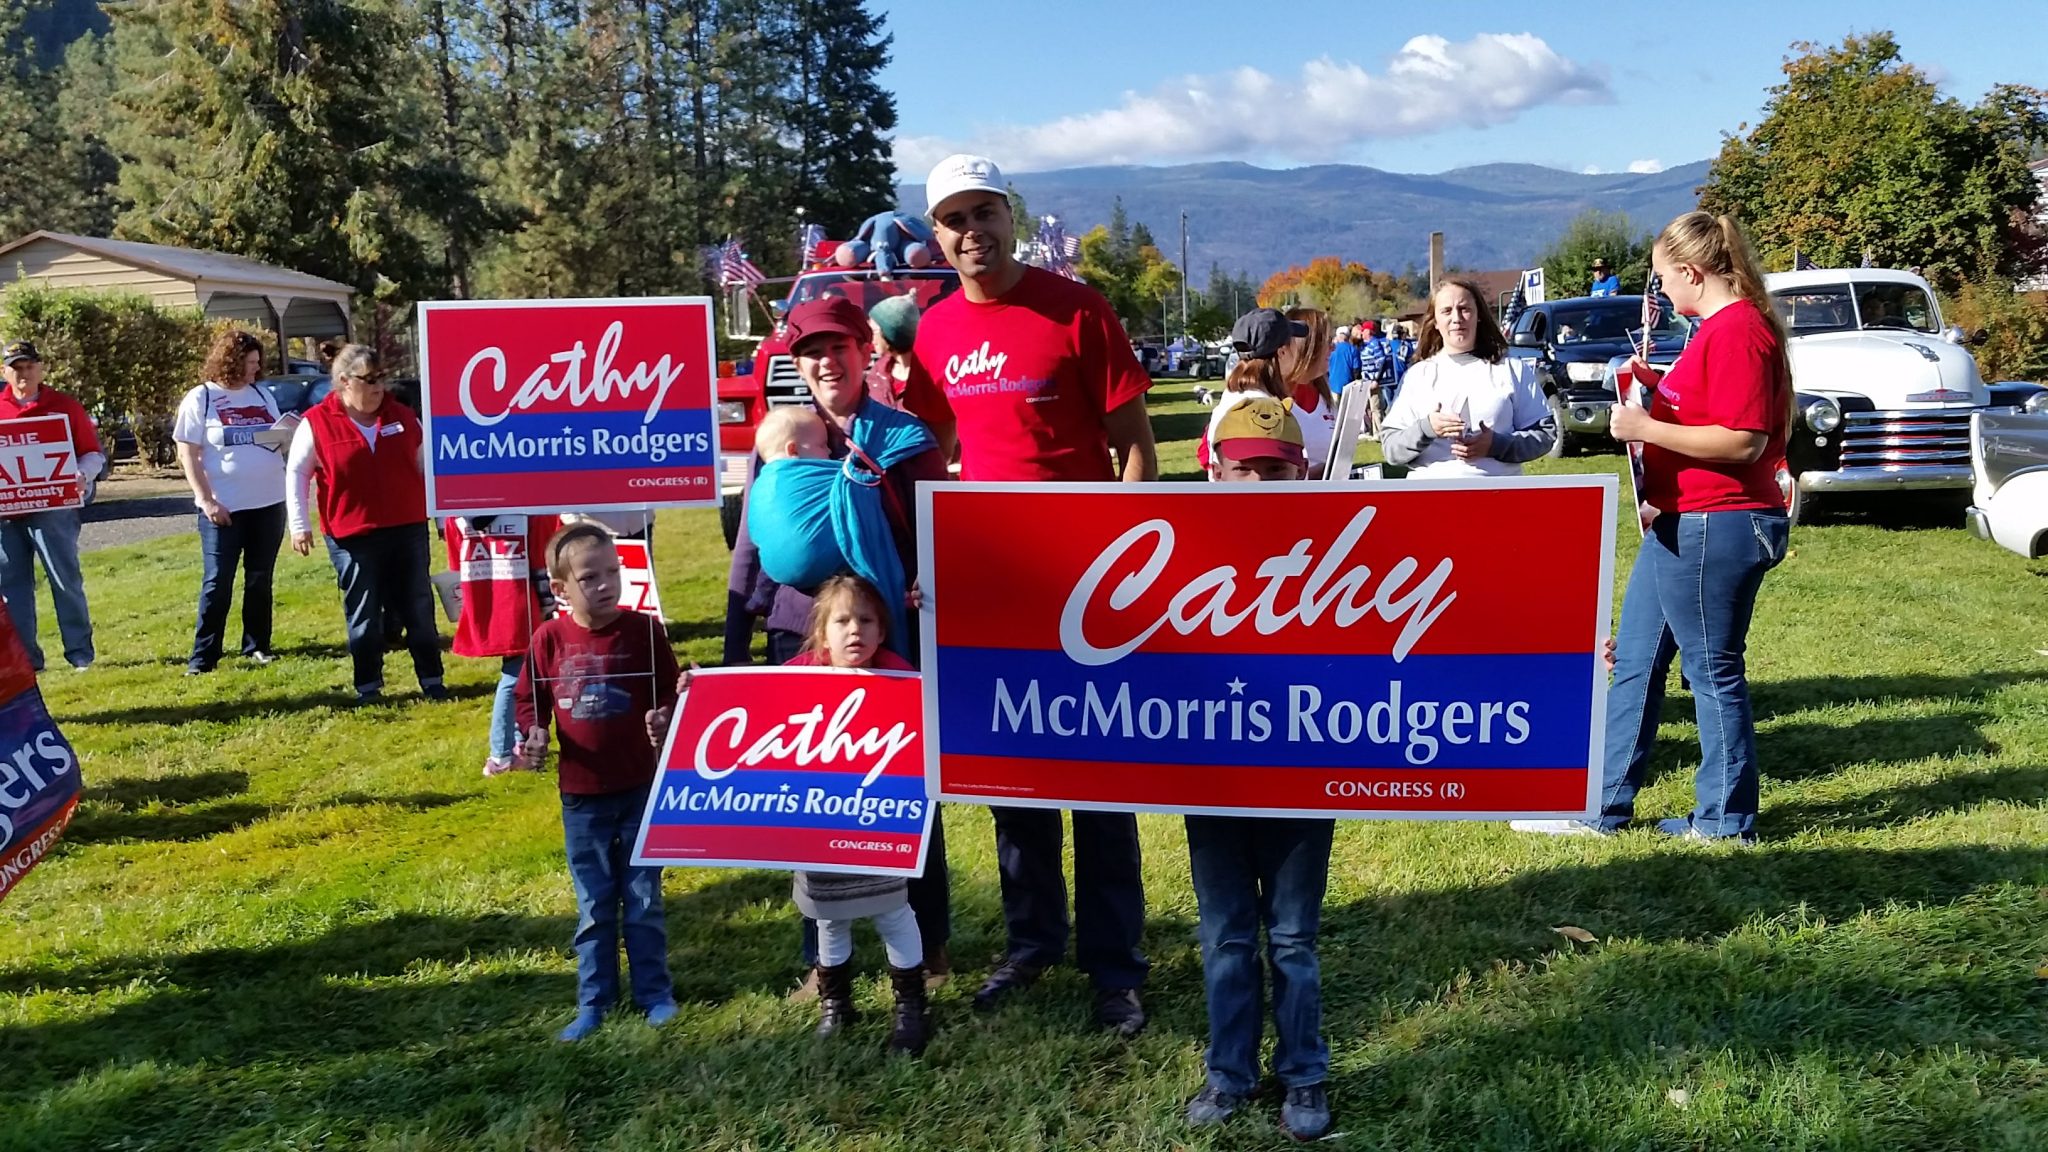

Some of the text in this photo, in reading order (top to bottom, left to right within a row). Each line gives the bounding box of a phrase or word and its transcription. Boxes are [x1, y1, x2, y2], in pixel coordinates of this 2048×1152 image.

[458, 321, 685, 426] Cathy
[945, 341, 1008, 385] Cathy
[439, 425, 709, 462] McMorris Rodgers
[17, 486, 64, 498] County
[628, 476, 708, 487] CONGRESS (R)
[1059, 505, 1457, 665] Cathy
[694, 688, 917, 788] Cathy
[992, 676, 1530, 765] McMorris Rodgers
[659, 783, 922, 826] McMorris Rodgers
[1325, 781, 1466, 800] CONGRESS (R)
[829, 838, 912, 854] CONGRESS (R)
